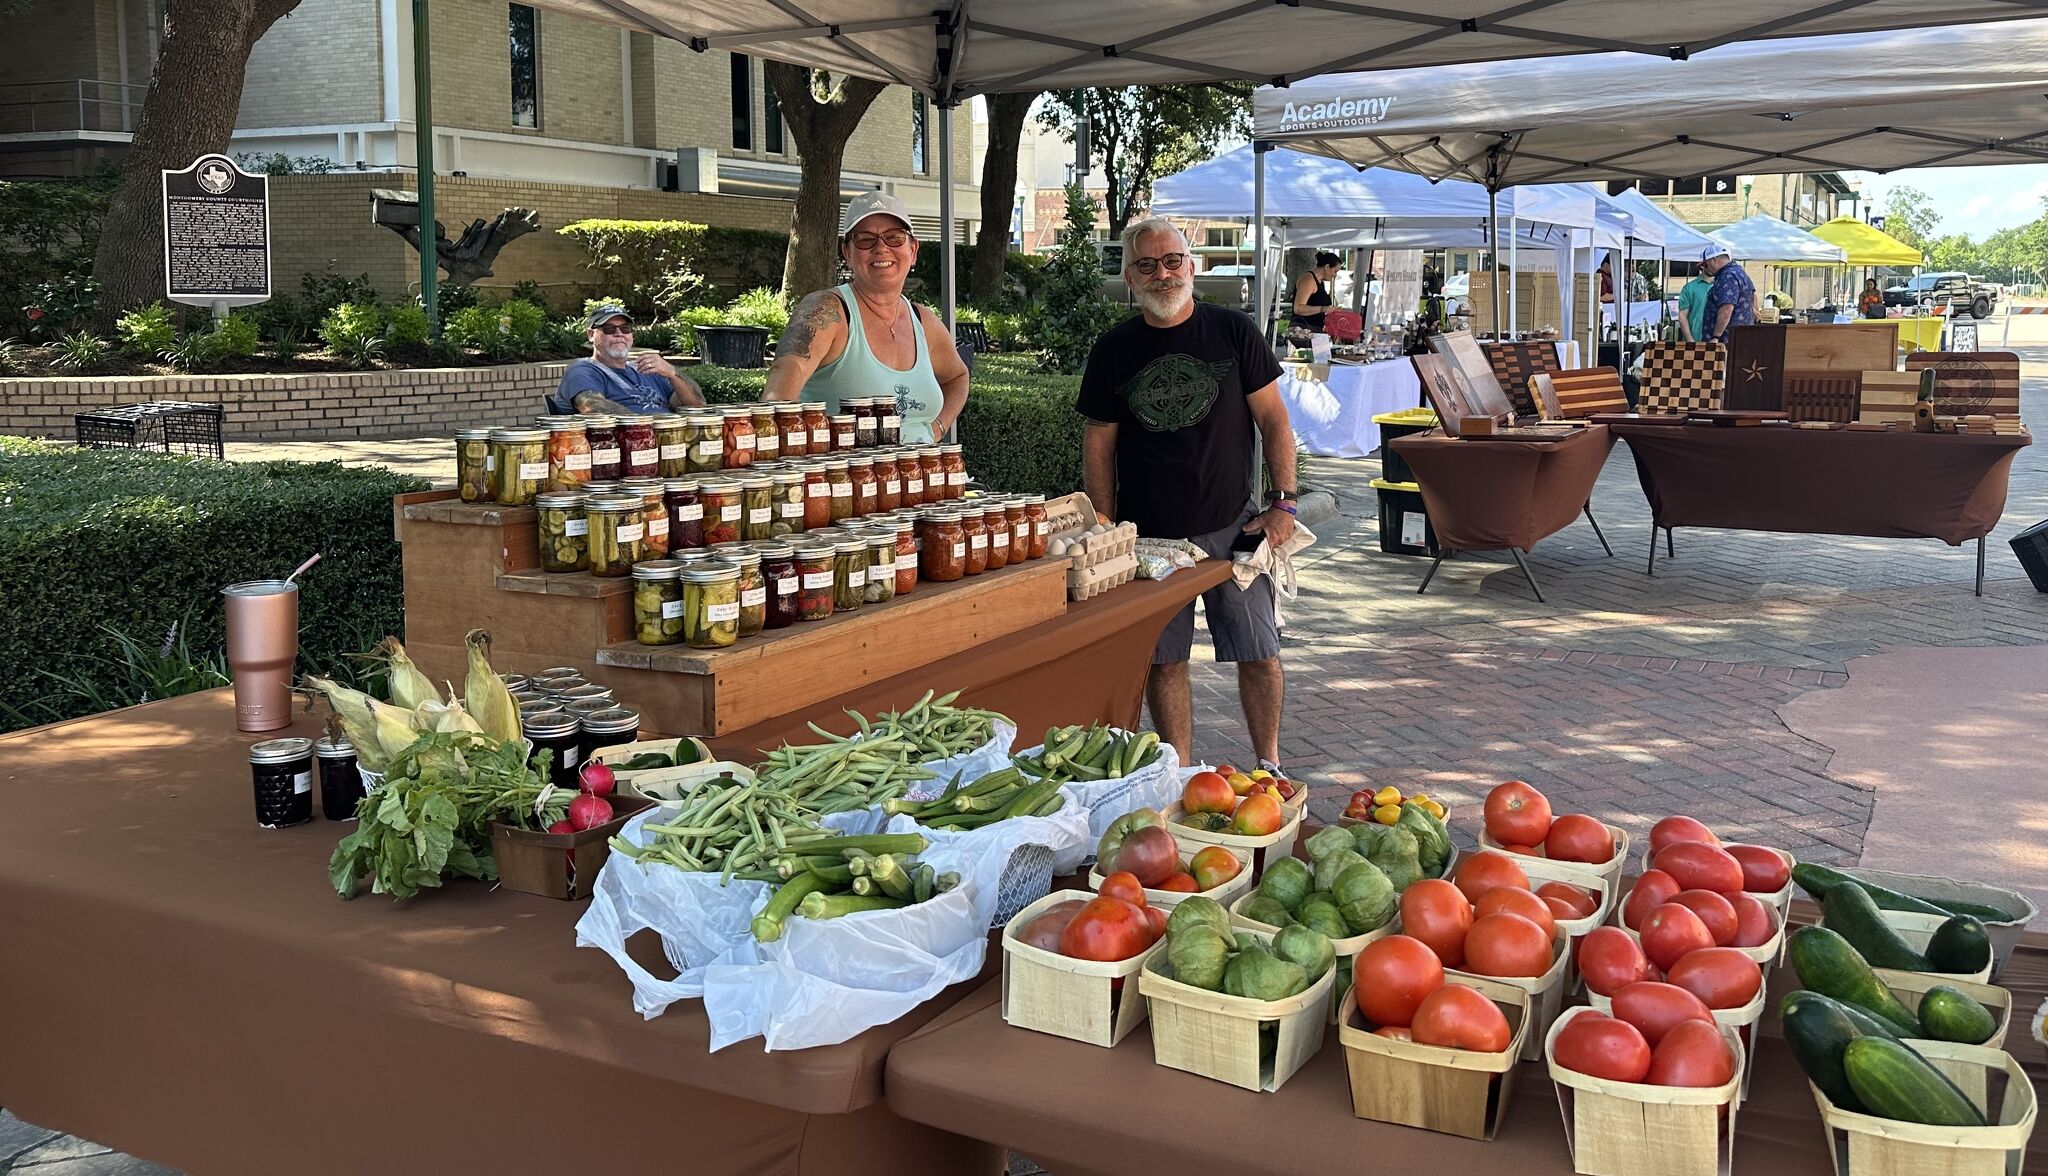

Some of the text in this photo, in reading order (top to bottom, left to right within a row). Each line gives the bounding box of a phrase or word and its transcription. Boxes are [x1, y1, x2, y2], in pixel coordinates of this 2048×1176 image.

[1281, 96, 1392, 121] Academy
[1279, 116, 1378, 132] SPORTS+OUTDOORS
[1135, 380, 1208, 403] IRELAND
[1138, 398, 1209, 426] LIMITED EDITION
